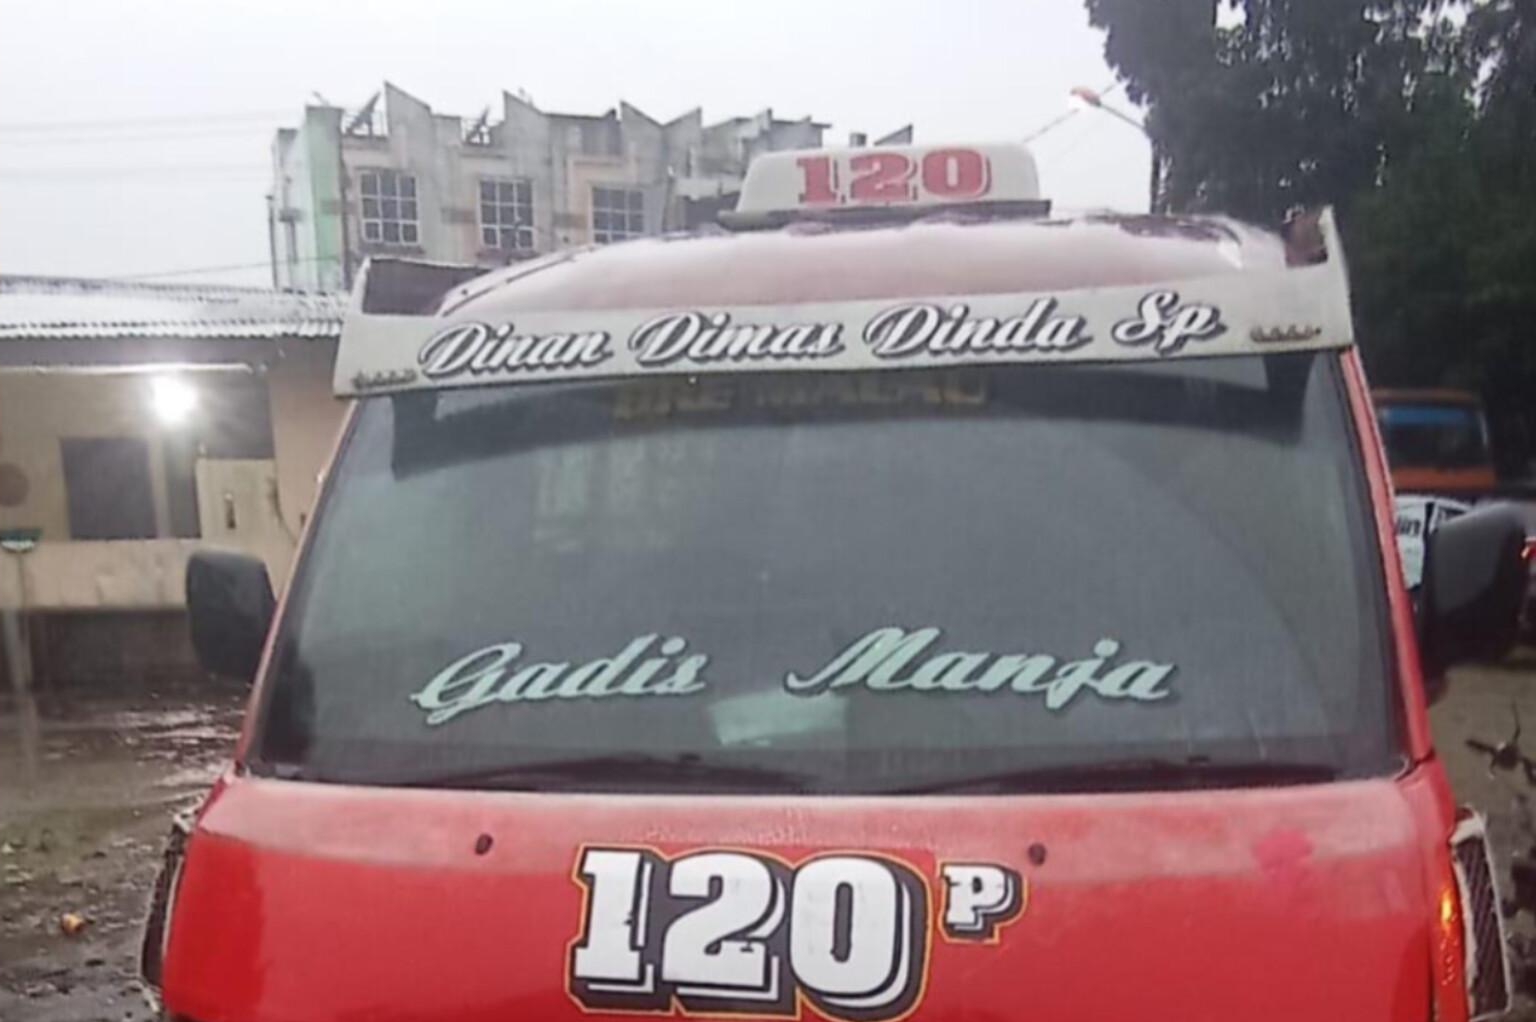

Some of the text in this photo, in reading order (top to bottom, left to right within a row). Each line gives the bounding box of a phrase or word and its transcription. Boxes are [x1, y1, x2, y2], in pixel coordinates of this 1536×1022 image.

[795, 149, 991, 203] 120
[419, 321, 614, 379] Dinan
[629, 312, 845, 367] Dimas
[864, 299, 1092, 357] Dinda
[411, 625, 1179, 724] Gadis Manja
[567, 846, 1022, 1020] 120 P
